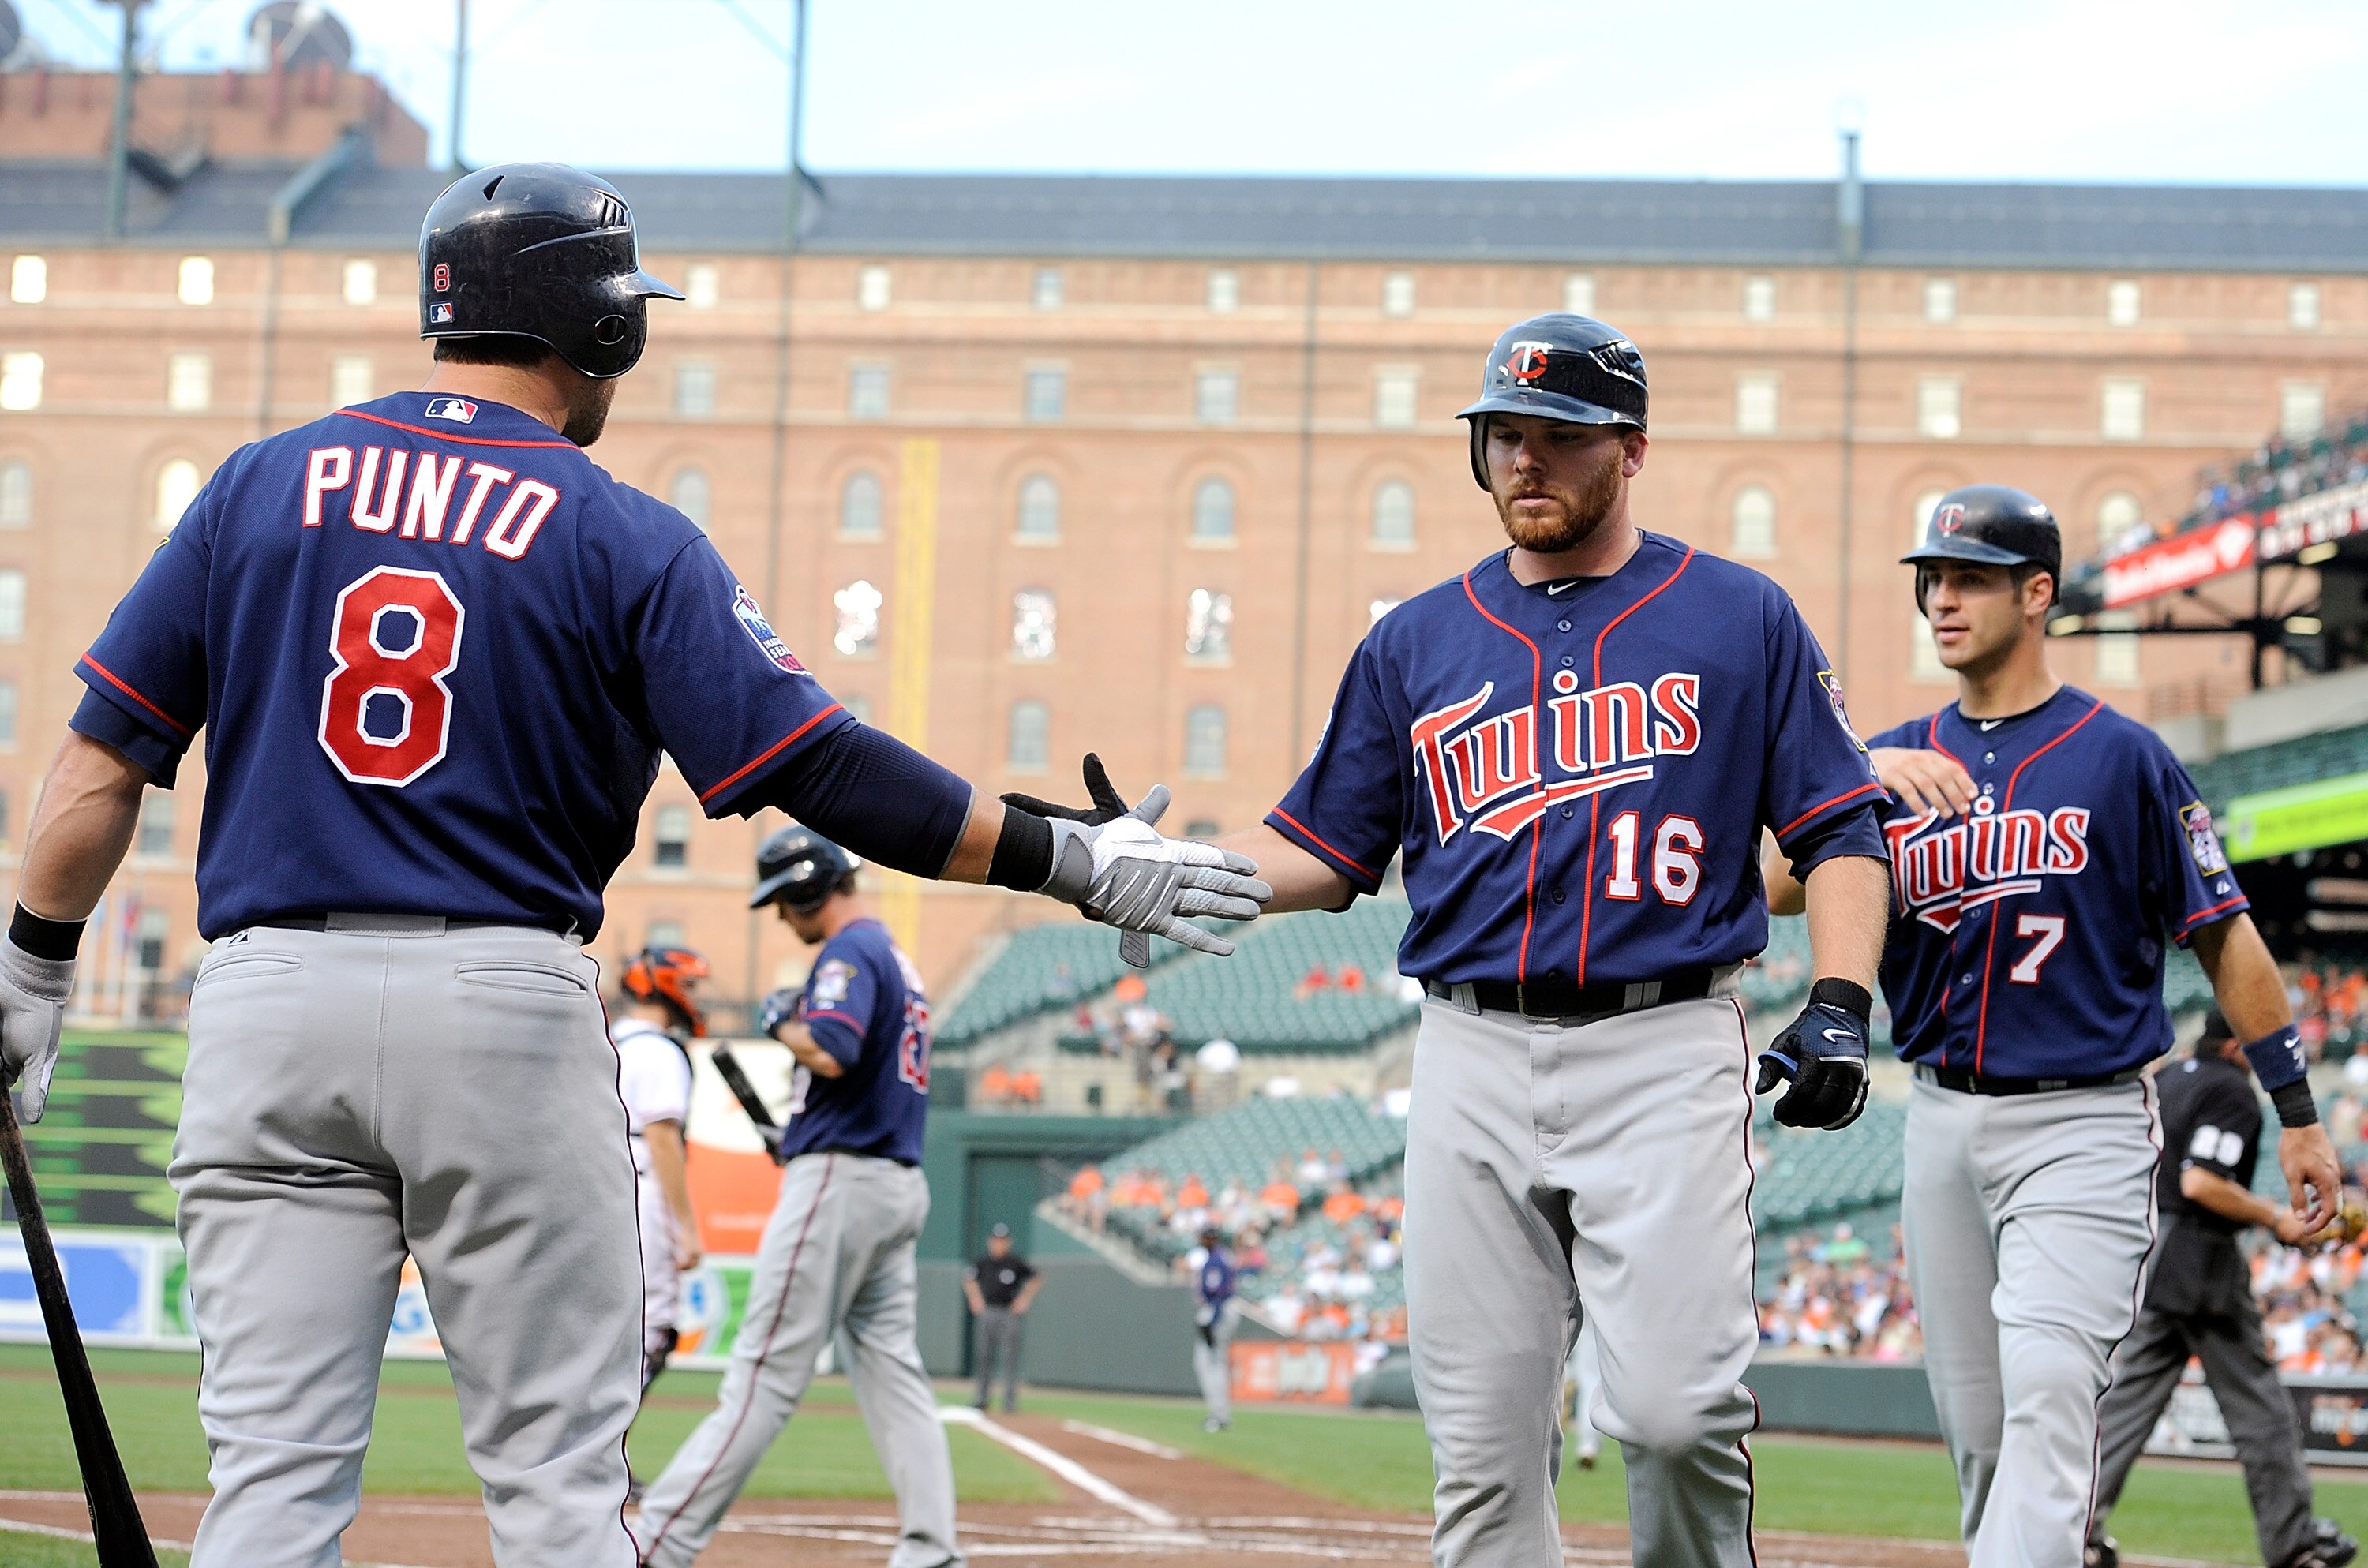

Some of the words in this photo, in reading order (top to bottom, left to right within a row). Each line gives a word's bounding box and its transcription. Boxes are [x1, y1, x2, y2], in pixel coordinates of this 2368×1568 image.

[434, 264, 450, 292] 8
[303, 445, 560, 561] PUNTO
[318, 565, 465, 788] 8
[1411, 669, 1701, 848] Twins
[1605, 810, 1706, 907] 16
[1883, 795, 2091, 920] Twins
[2010, 912, 2067, 985] 7
